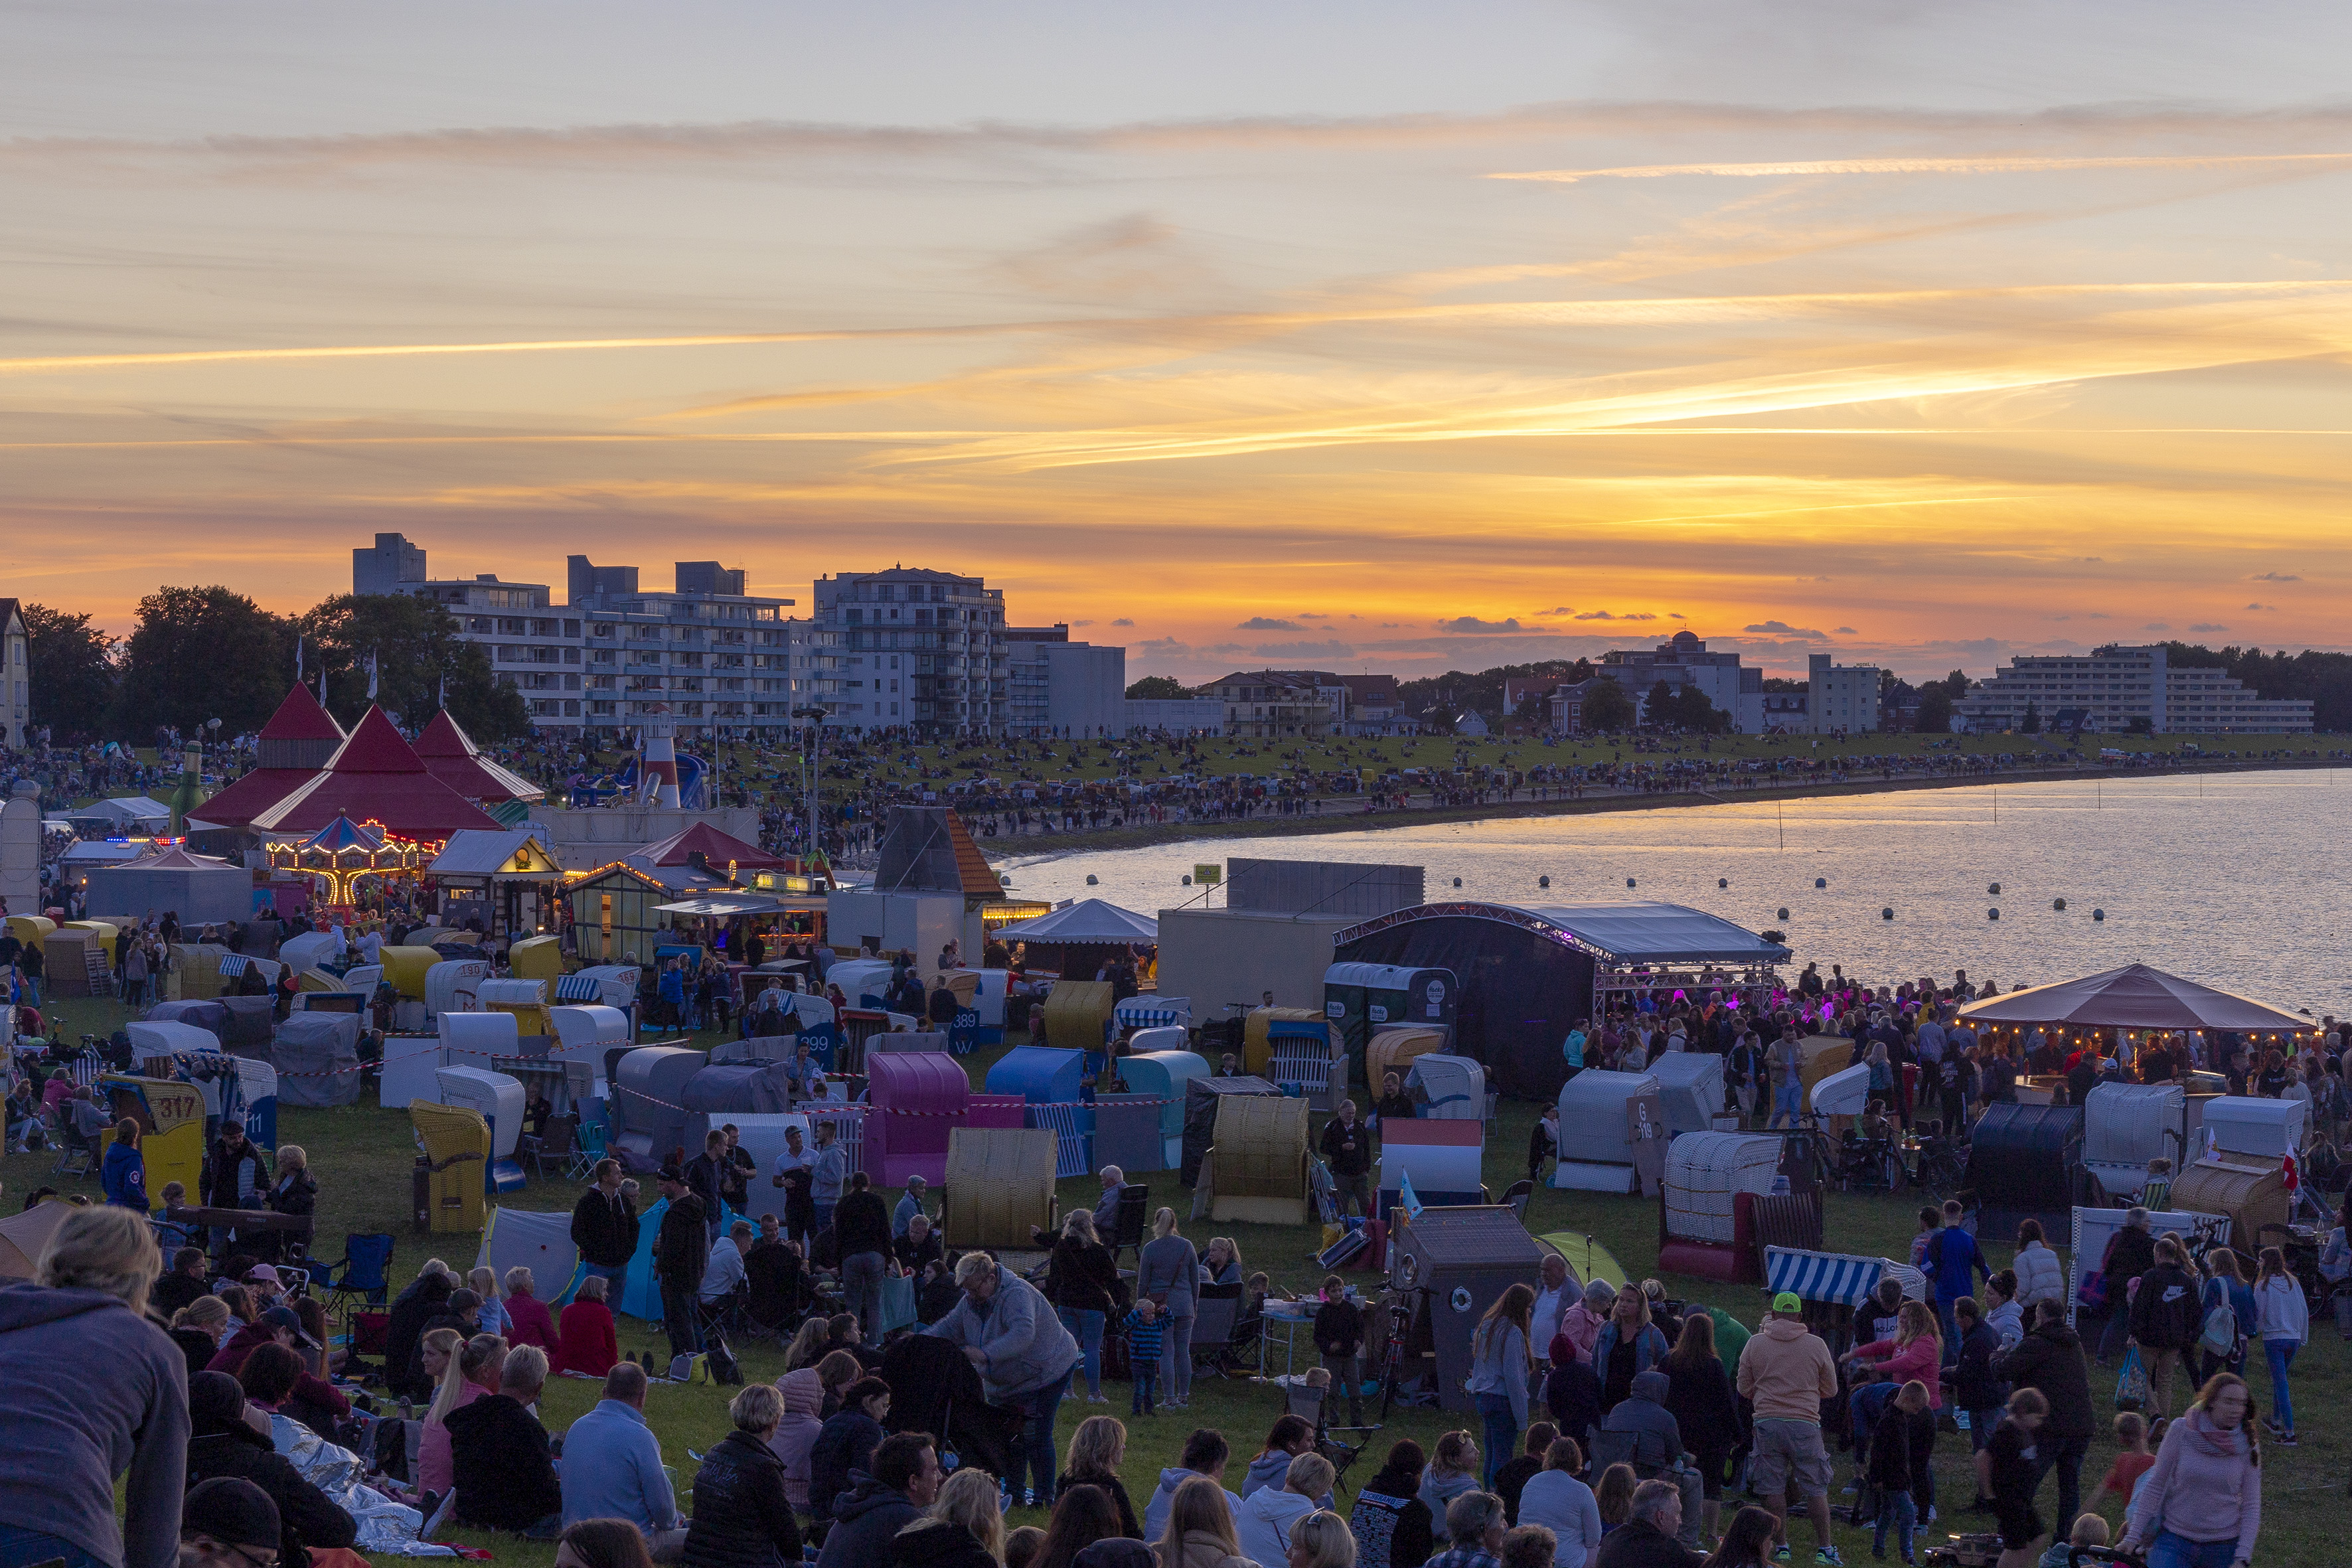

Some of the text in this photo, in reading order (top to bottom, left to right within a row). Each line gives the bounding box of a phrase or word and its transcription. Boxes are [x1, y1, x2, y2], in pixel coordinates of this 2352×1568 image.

[461, 965, 480, 975] 190
[618, 972, 635, 983] 369
[953, 1014, 976, 1028] 389
[955, 1041, 973, 1054] W
[160, 1096, 195, 1118] 317
[1639, 1102, 1646, 1121] G
